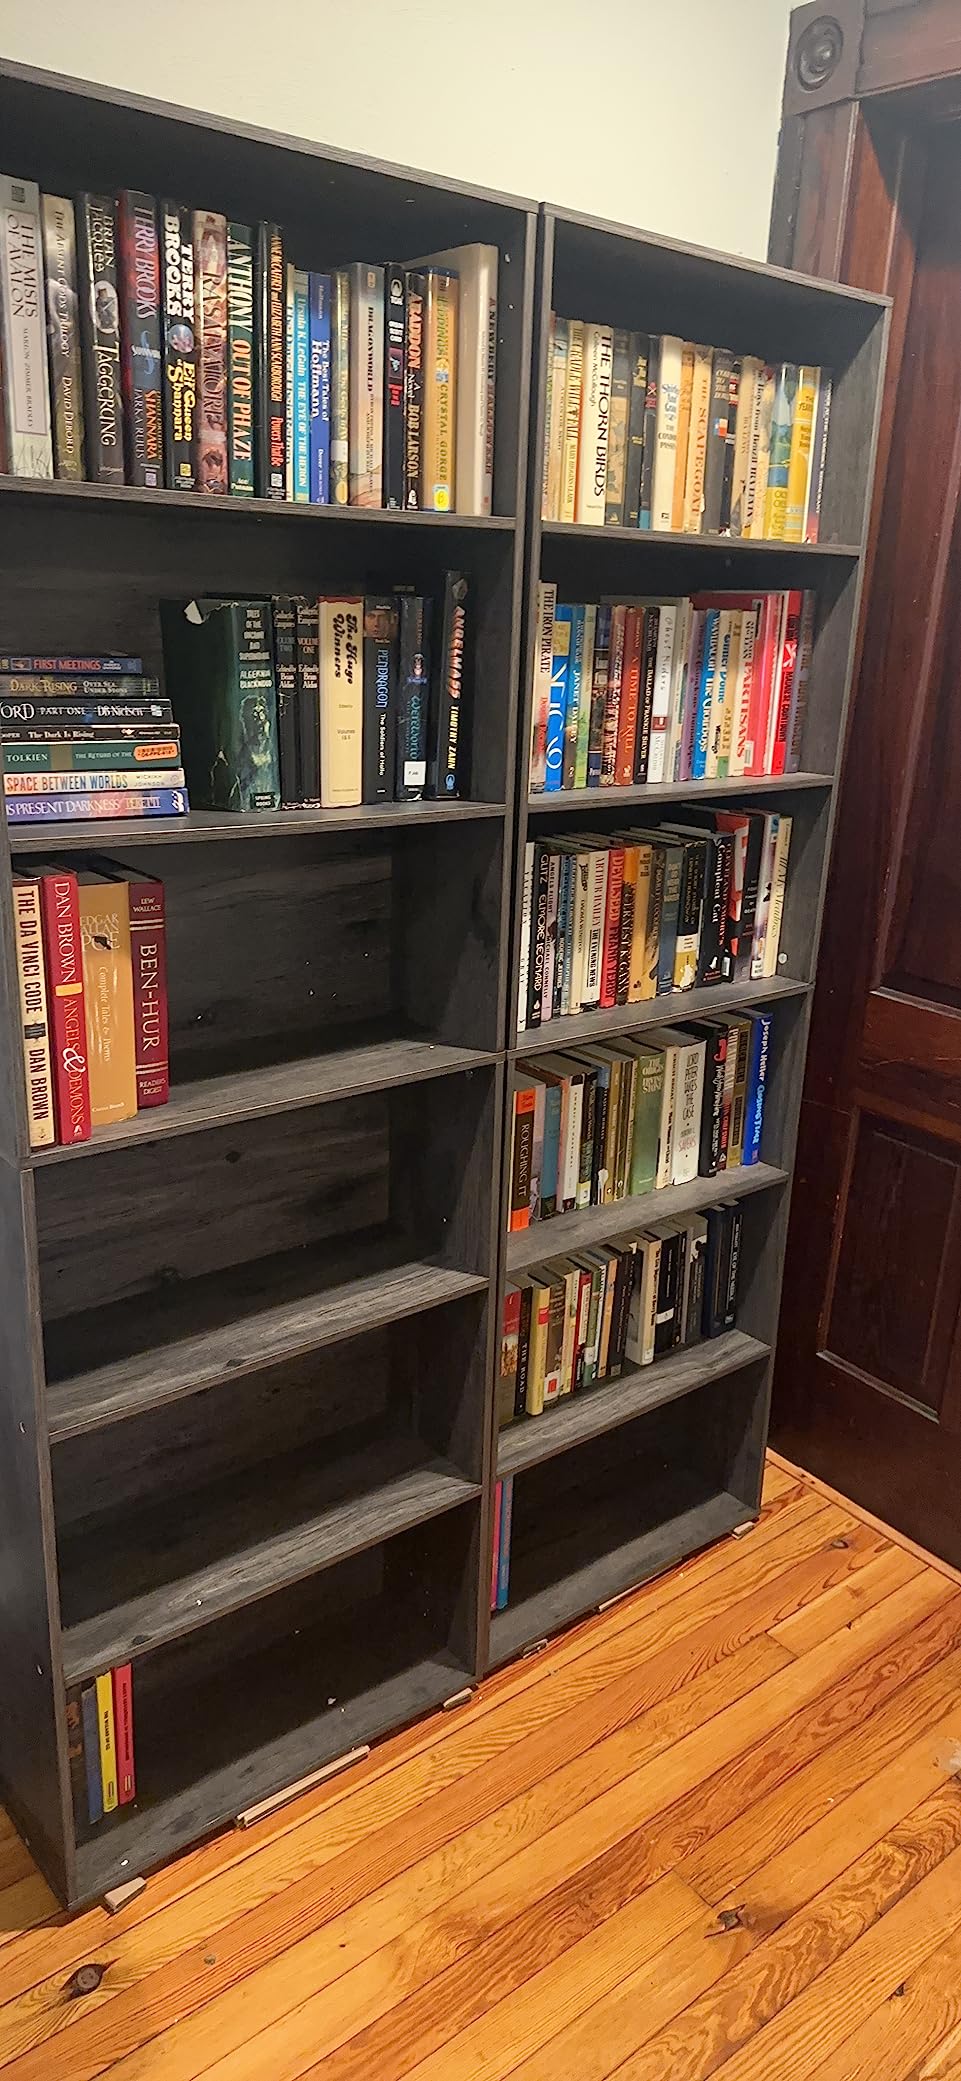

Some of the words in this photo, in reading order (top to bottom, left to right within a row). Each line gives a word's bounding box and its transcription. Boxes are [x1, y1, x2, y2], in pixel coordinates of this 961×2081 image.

[8, 214, 20, 239] OF
[55, 211, 65, 231] THE
[134, 207, 160, 256] TERRY
[21, 224, 36, 260] THE
[55, 234, 67, 274] ABSENT
[102, 215, 115, 269] BRIAN
[8, 242, 24, 318] AVALON
[164, 214, 182, 318] BROOKS
[23, 265, 38, 318] MISTS
[58, 278, 68, 308] GODS
[135, 259, 158, 319] BROOKS
[181, 244, 194, 324] TERRY
[228, 239, 253, 333] ANTHONY
[60, 311, 71, 359] TRILOGY
[407, 291, 423, 369] ABADDON
[488, 311, 496, 380] NEWBERY
[233, 340, 251, 369] OUT
[322, 340, 330, 359] The
[600, 335, 612, 368] THE
[233, 372, 251, 401] OF
[311, 340, 322, 418] Hoffmann
[322, 361, 330, 384] Best
[62, 375, 73, 408] DAVID
[92, 341, 120, 447] TAGGERUNG
[134, 389, 144, 423] JARKA
[168, 365, 183, 442] Shannara
[298, 382, 306, 400] THE
[322, 385, 330, 410] Tales
[145, 390, 159, 459] SHANNARA
[184, 391, 195, 442] Queen
[298, 402, 306, 421] EYE
[322, 412, 330, 422] of
[407, 404, 421, 428] BOB
[440, 384, 449, 435] CRYSTAL
[597, 375, 611, 441] THORN
[64, 411, 75, 454] DEBORD
[135, 426, 145, 459] RUUS
[232, 404, 252, 461] PHAZE
[270, 417, 284, 441] Powers
[298, 422, 306, 434] OF
[298, 435, 306, 451] THE
[270, 442, 283, 458] That
[270, 458, 281, 467] Be
[405, 430, 420, 479] LARSON
[439, 441, 448, 481] GORGE
[691, 407, 706, 517] SCAPEGOAT
[298, 453, 307, 487] HERON
[594, 446, 608, 497] BIRDS
[543, 590, 554, 610] THE
[345, 613, 358, 638] The
[542, 611, 554, 638] IRON
[332, 613, 345, 679] Winners
[540, 639, 553, 674] PIRATE
[33, 660, 59, 670] FIRST
[61, 660, 100, 670] MEETINGS
[344, 642, 358, 684] Hugo
[374, 649, 389, 708] PENDRAGON
[44, 680, 78, 693] RISING
[572, 670, 580, 703] JANET
[628, 670, 639, 701] TIME
[645, 670, 654, 696] BALLAD
[0, 702, 35, 721] ORD
[40, 707, 64, 716] PART
[66, 706, 87, 716] ONE
[448, 706, 460, 744] TIMOTHY
[570, 706, 579, 744] DAILEY
[628, 706, 636, 722] TO
[642, 705, 652, 734] FRANKIE
[736, 662, 752, 758] PARTISANS
[44, 730, 62, 738] Dark
[378, 727, 386, 750] Soldiers
[620, 725, 635, 754] KILL
[640, 736, 650, 760] SILVER
[6, 753, 48, 762] TOLKIEN
[88, 752, 110, 760] RETURN
[448, 746, 458, 769] ZAHN
[7, 776, 38, 792] SPACE
[42, 775, 86, 791] BETWEEN
[90, 774, 129, 790] WORLDS
[16, 802, 66, 816] PRESENT
[67, 799, 120, 813] DARKNESS
[539, 854, 548, 885] GLITZ
[714, 844, 726, 899] Compleat
[18, 890, 36, 914] THE
[54, 882, 71, 919] DAN
[610, 856, 626, 922] DEVILSEED
[132, 904, 162, 912] WALLACE
[537, 894, 546, 941] ELMORE
[620, 903, 632, 944] ERNEST
[20, 920, 38, 938] DA
[608, 926, 620, 963] FRANK
[22, 941, 41, 977] VINCI
[58, 923, 77, 984] BROWN
[534, 942, 544, 991] LEONARD
[544, 936, 552, 965] MICHAEL
[24, 982, 43, 1014] CODE
[98, 966, 110, 1004] Complete
[139, 943, 161, 1052] BEN-HUR
[605, 966, 616, 1000] YERBY
[63, 998, 82, 1050] ANGELS
[101, 1006, 111, 1025] Tales
[102, 1038, 112, 1062] Poems
[760, 1020, 772, 1054] Joseph
[29, 1048, 47, 1075] DAN
[62, 1048, 86, 1073] &
[684, 1065, 698, 1081] PETER
[758, 1055, 769, 1082] Heller
[31, 1078, 49, 1121] BROWN
[68, 1071, 86, 1124] DEMONS
[682, 1104, 695, 1120] CASE
[518, 1124, 530, 1183] ROUGHING
[518, 1186, 526, 1197] IT
